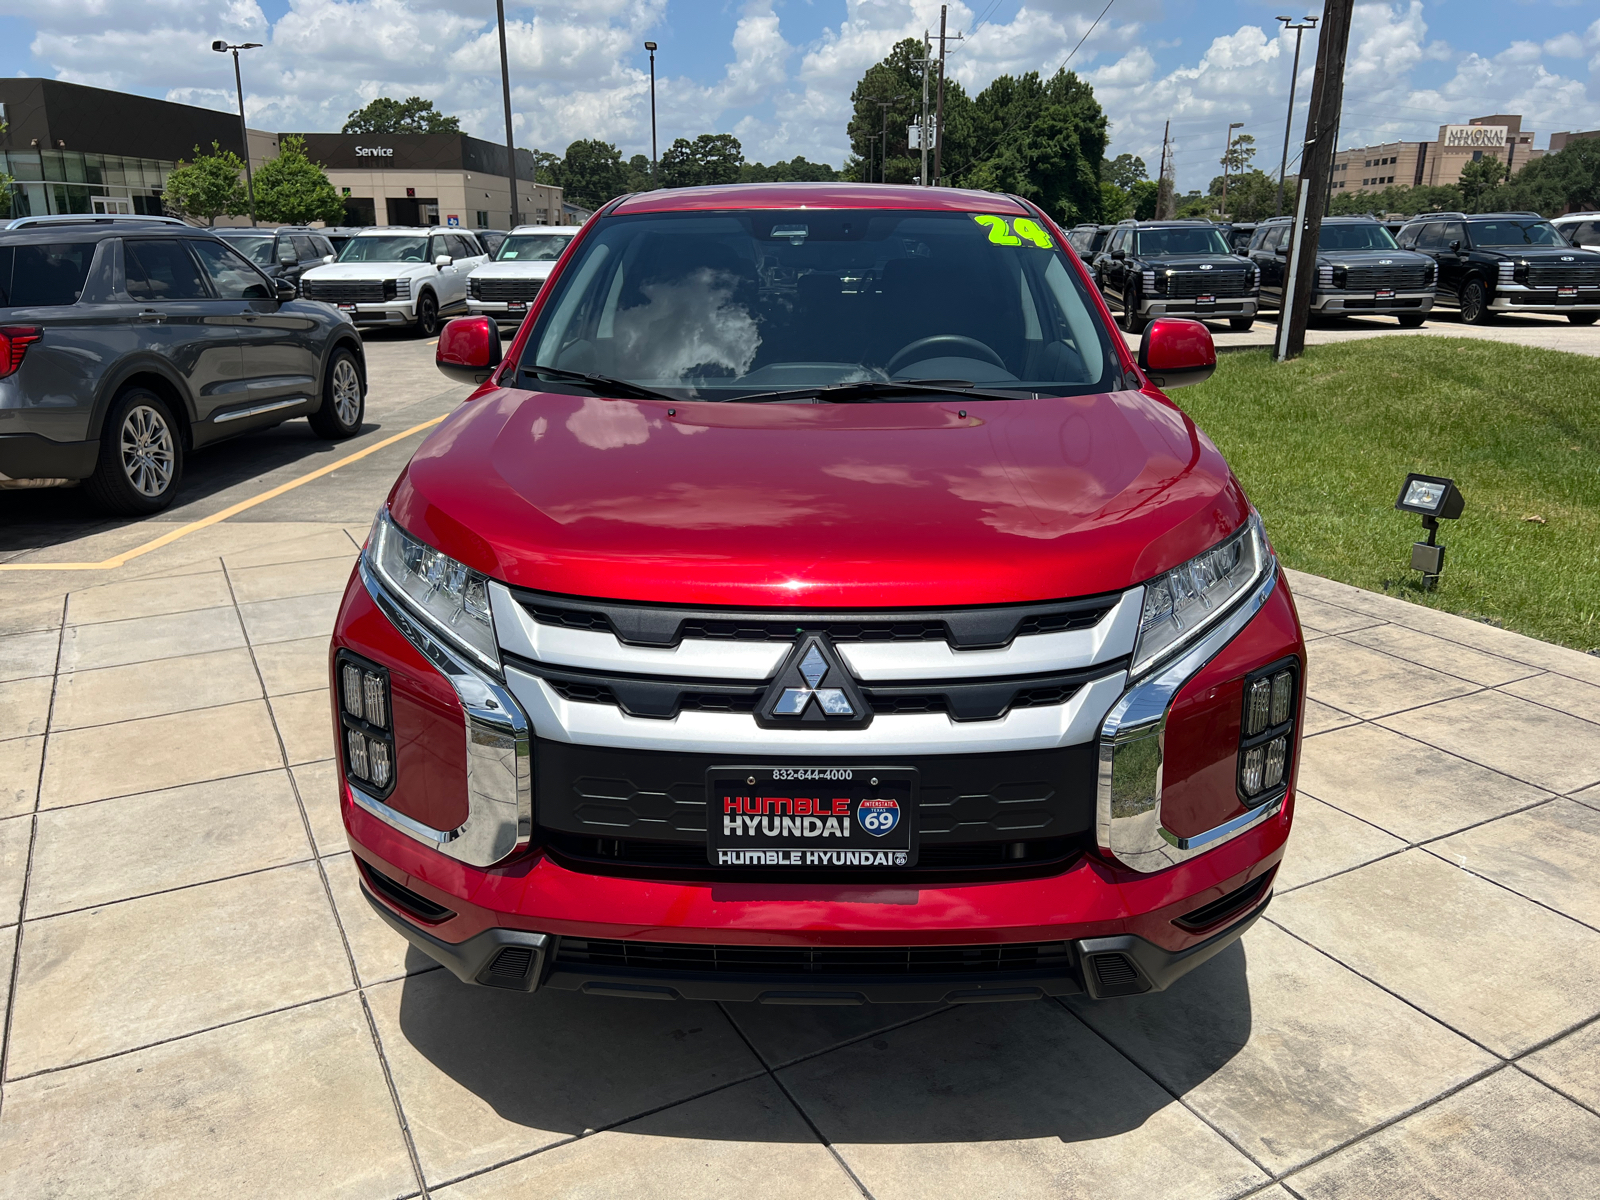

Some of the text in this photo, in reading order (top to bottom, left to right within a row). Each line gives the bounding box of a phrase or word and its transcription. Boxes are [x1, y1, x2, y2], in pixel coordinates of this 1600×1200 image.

[1450, 128, 1503, 139] MEMORIAL
[1448, 137, 1504, 146] HERMANN
[355, 146, 393, 157] Service
[974, 215, 1053, 249] 24
[772, 769, 853, 780] 832-644-4000
[723, 796, 851, 815] HUMBLE
[723, 815, 850, 837] HYUNDAI
[864, 812, 894, 830] 69
[718, 851, 802, 865] HUMBLE
[806, 851, 893, 866] HYUNDAI
